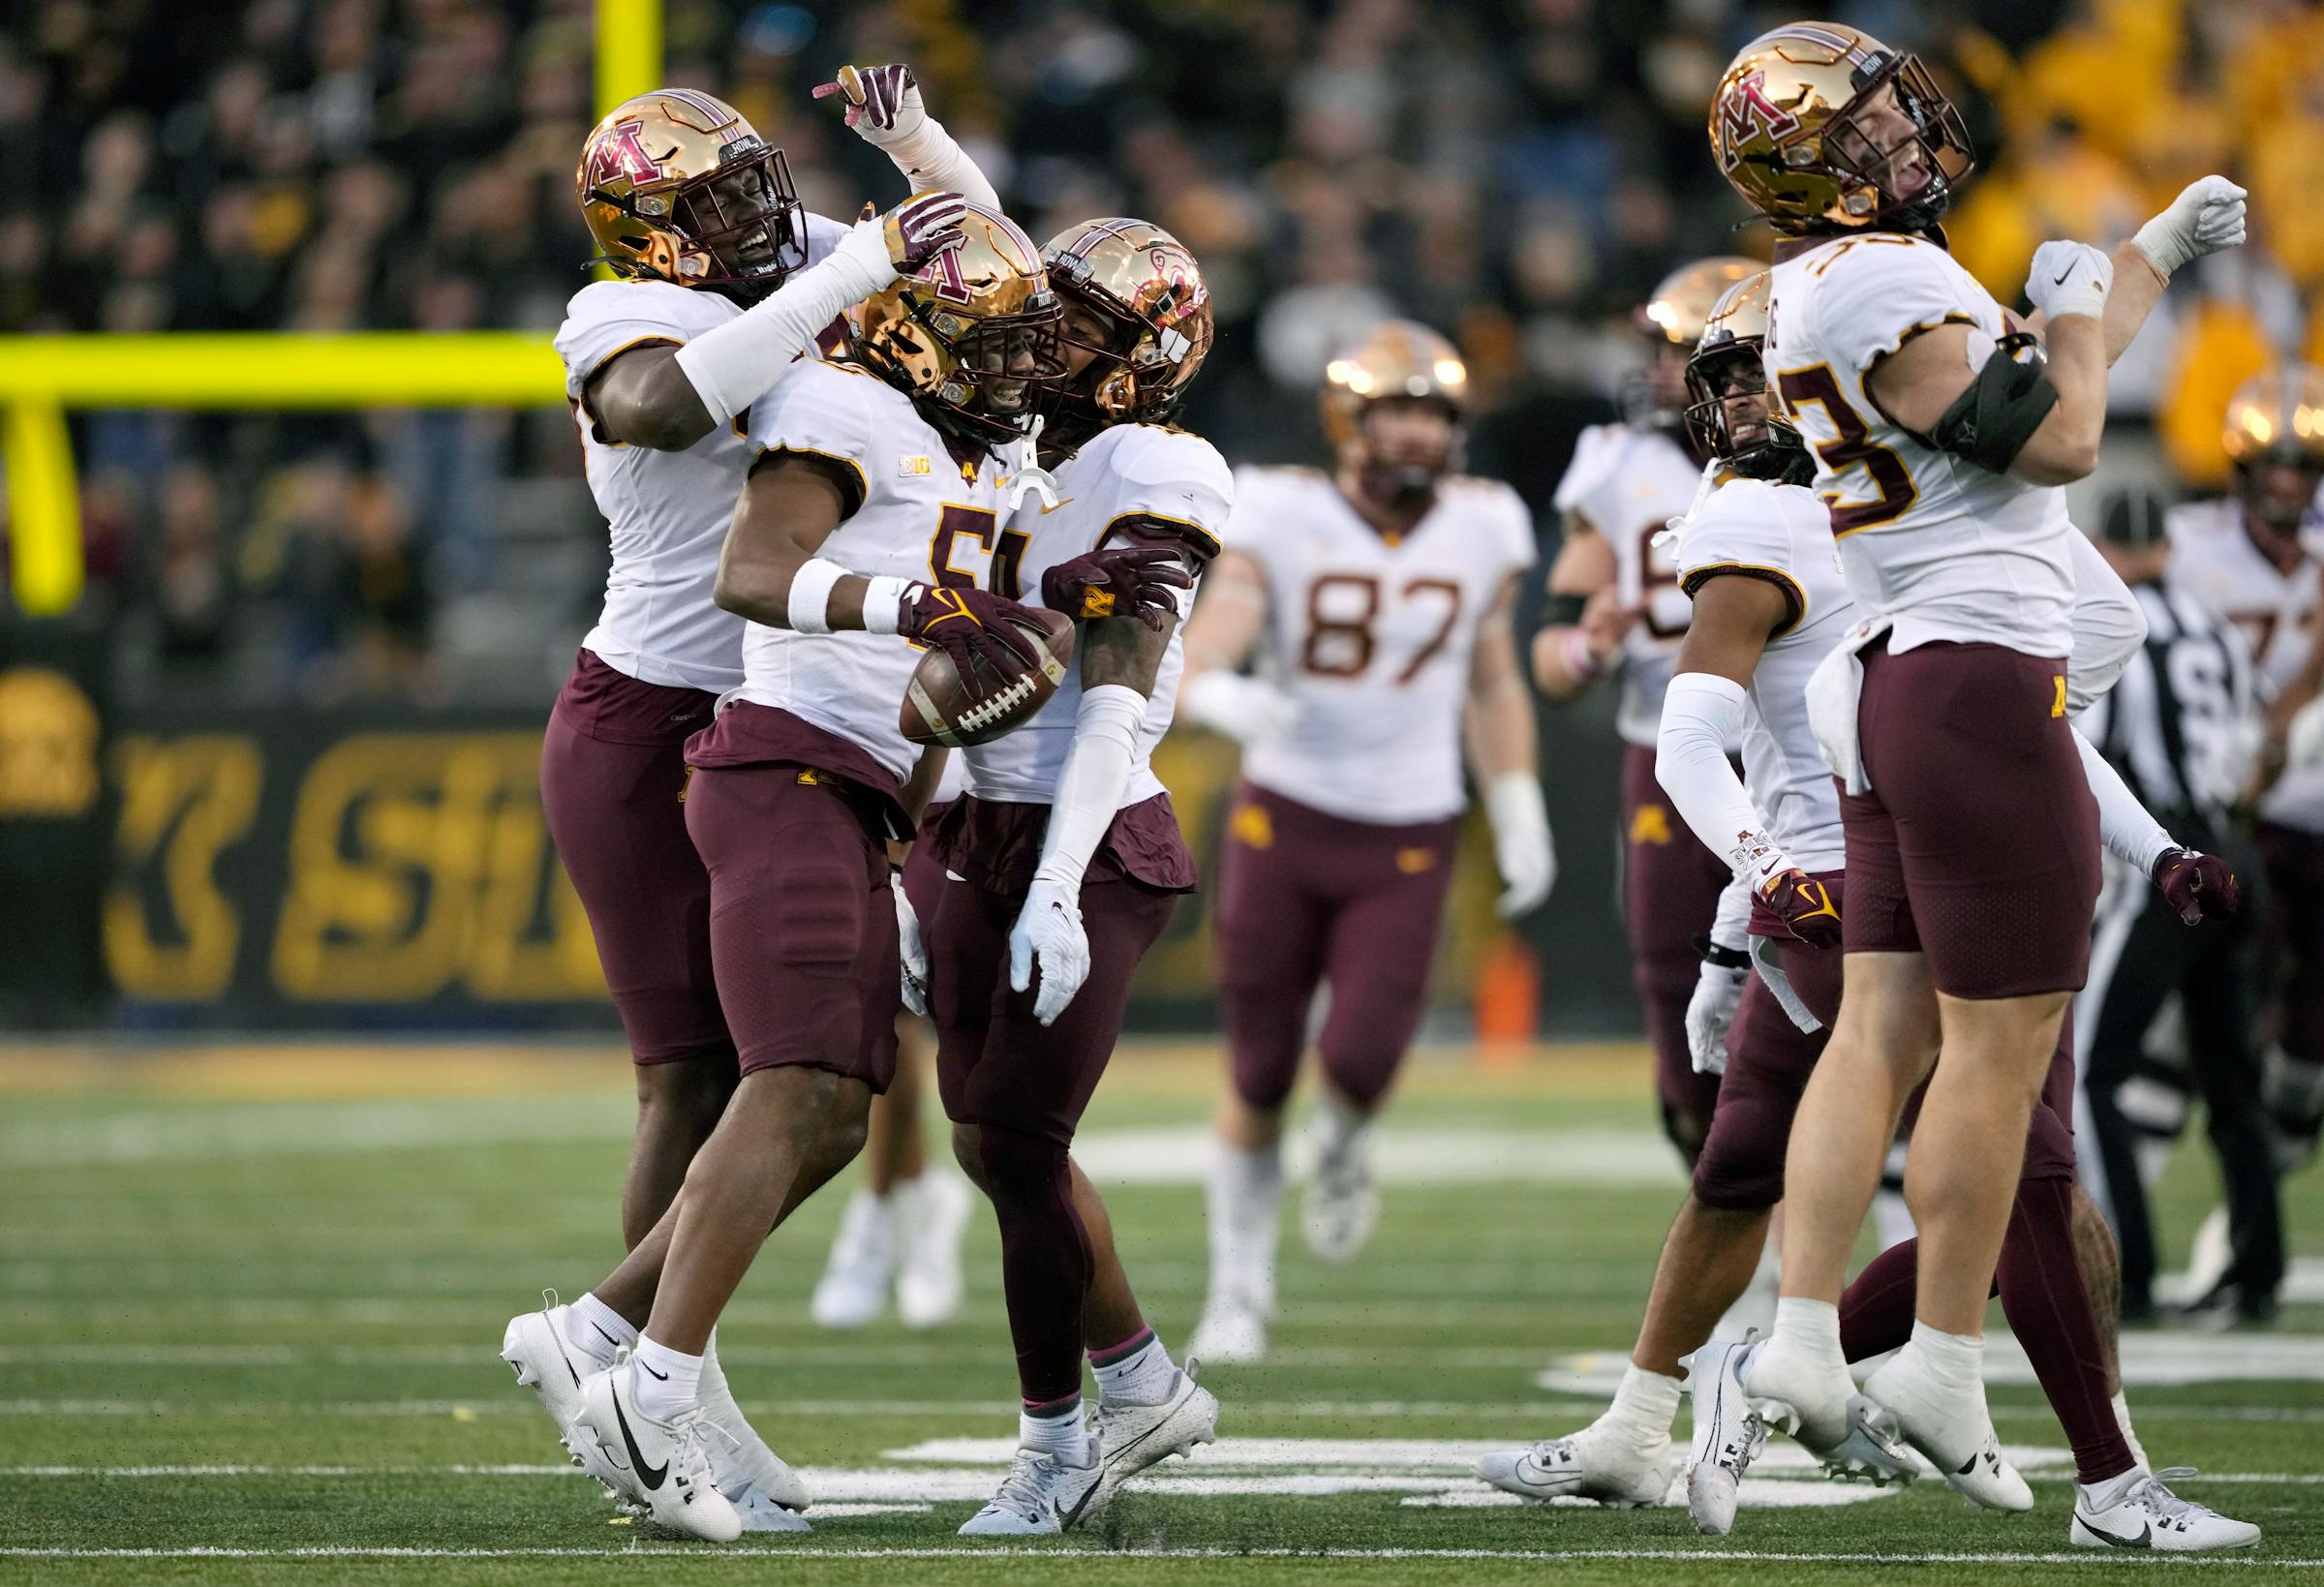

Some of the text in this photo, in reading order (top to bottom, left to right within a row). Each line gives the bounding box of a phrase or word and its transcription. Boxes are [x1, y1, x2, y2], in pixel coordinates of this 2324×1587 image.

[583, 120, 665, 207] M
[1720, 70, 1801, 172] M
[1056, 253, 1080, 271] ROW
[1303, 574, 1462, 685] 87
